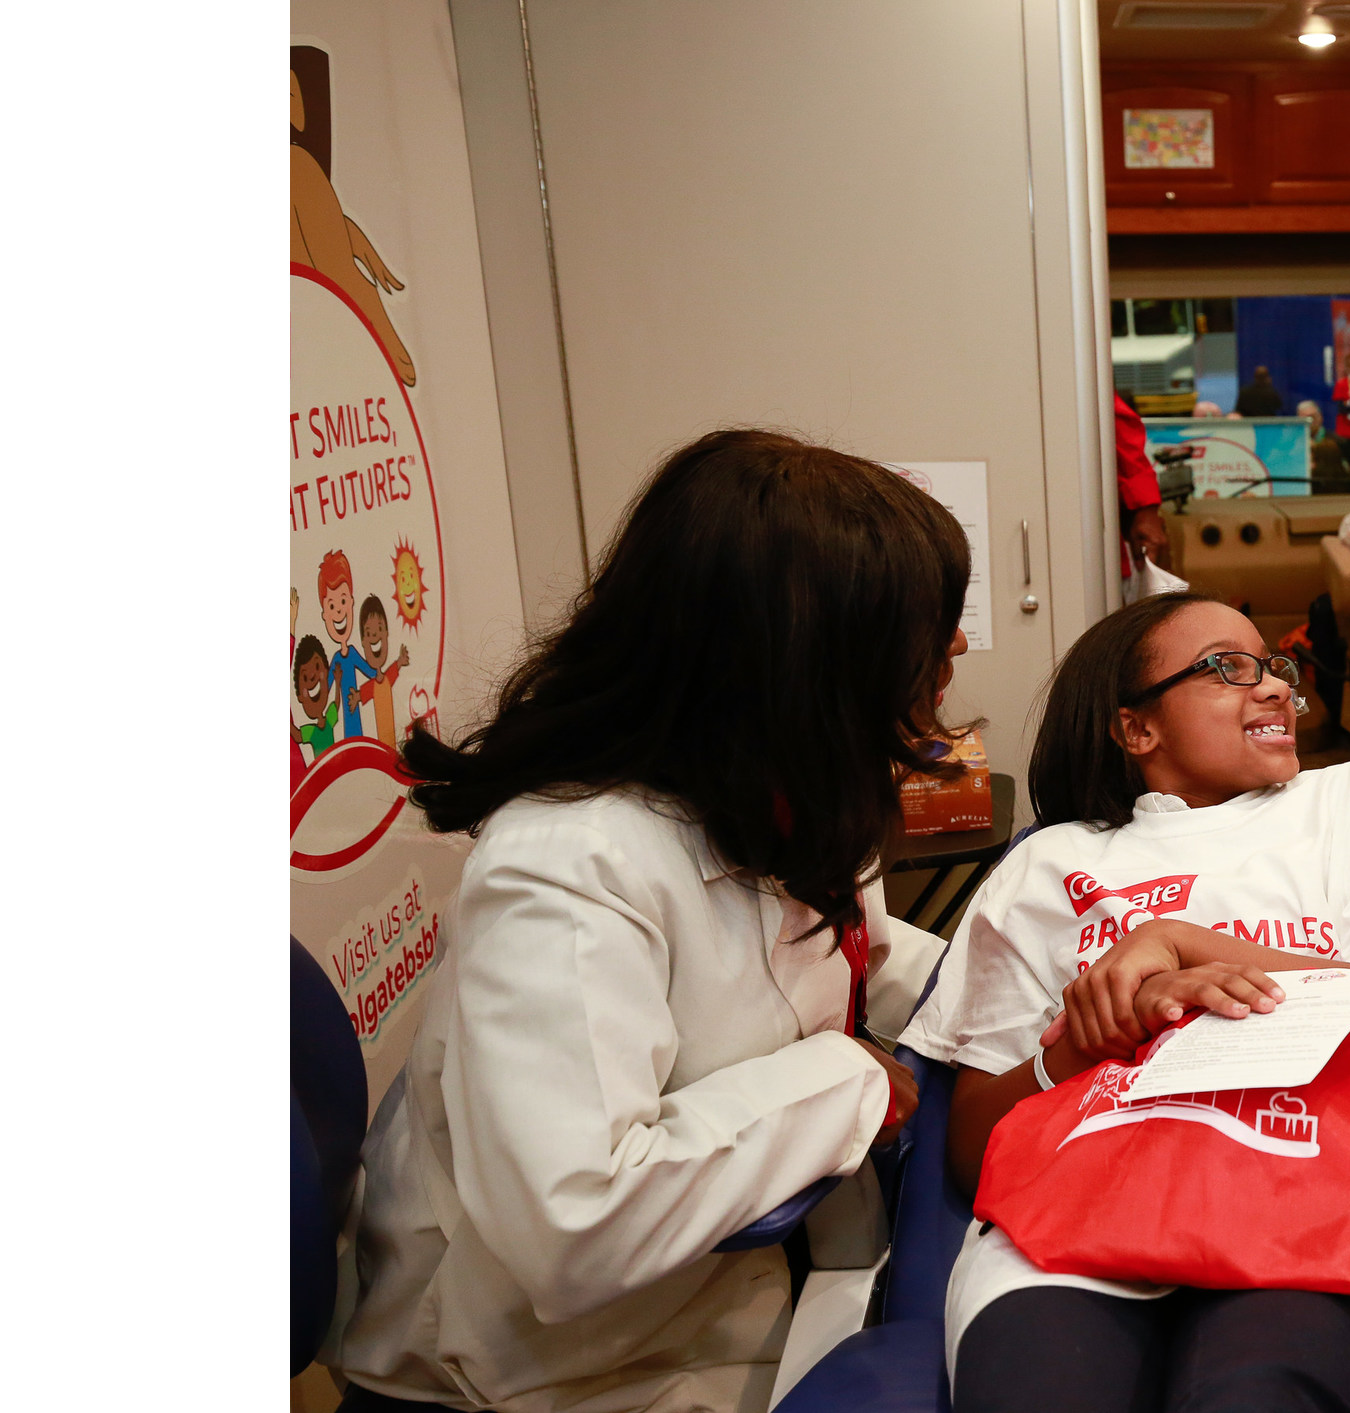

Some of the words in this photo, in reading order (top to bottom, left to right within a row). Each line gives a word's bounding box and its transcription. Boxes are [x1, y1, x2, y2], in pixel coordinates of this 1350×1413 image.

[308, 397, 397, 458] SMILES,
[1069, 874, 1182, 909] Coate
[332, 922, 378, 988] Visit
[379, 905, 401, 945] us
[404, 879, 421, 921] at
[1210, 916, 1339, 960] MILES,
[349, 912, 439, 1038] olgatebsbf
